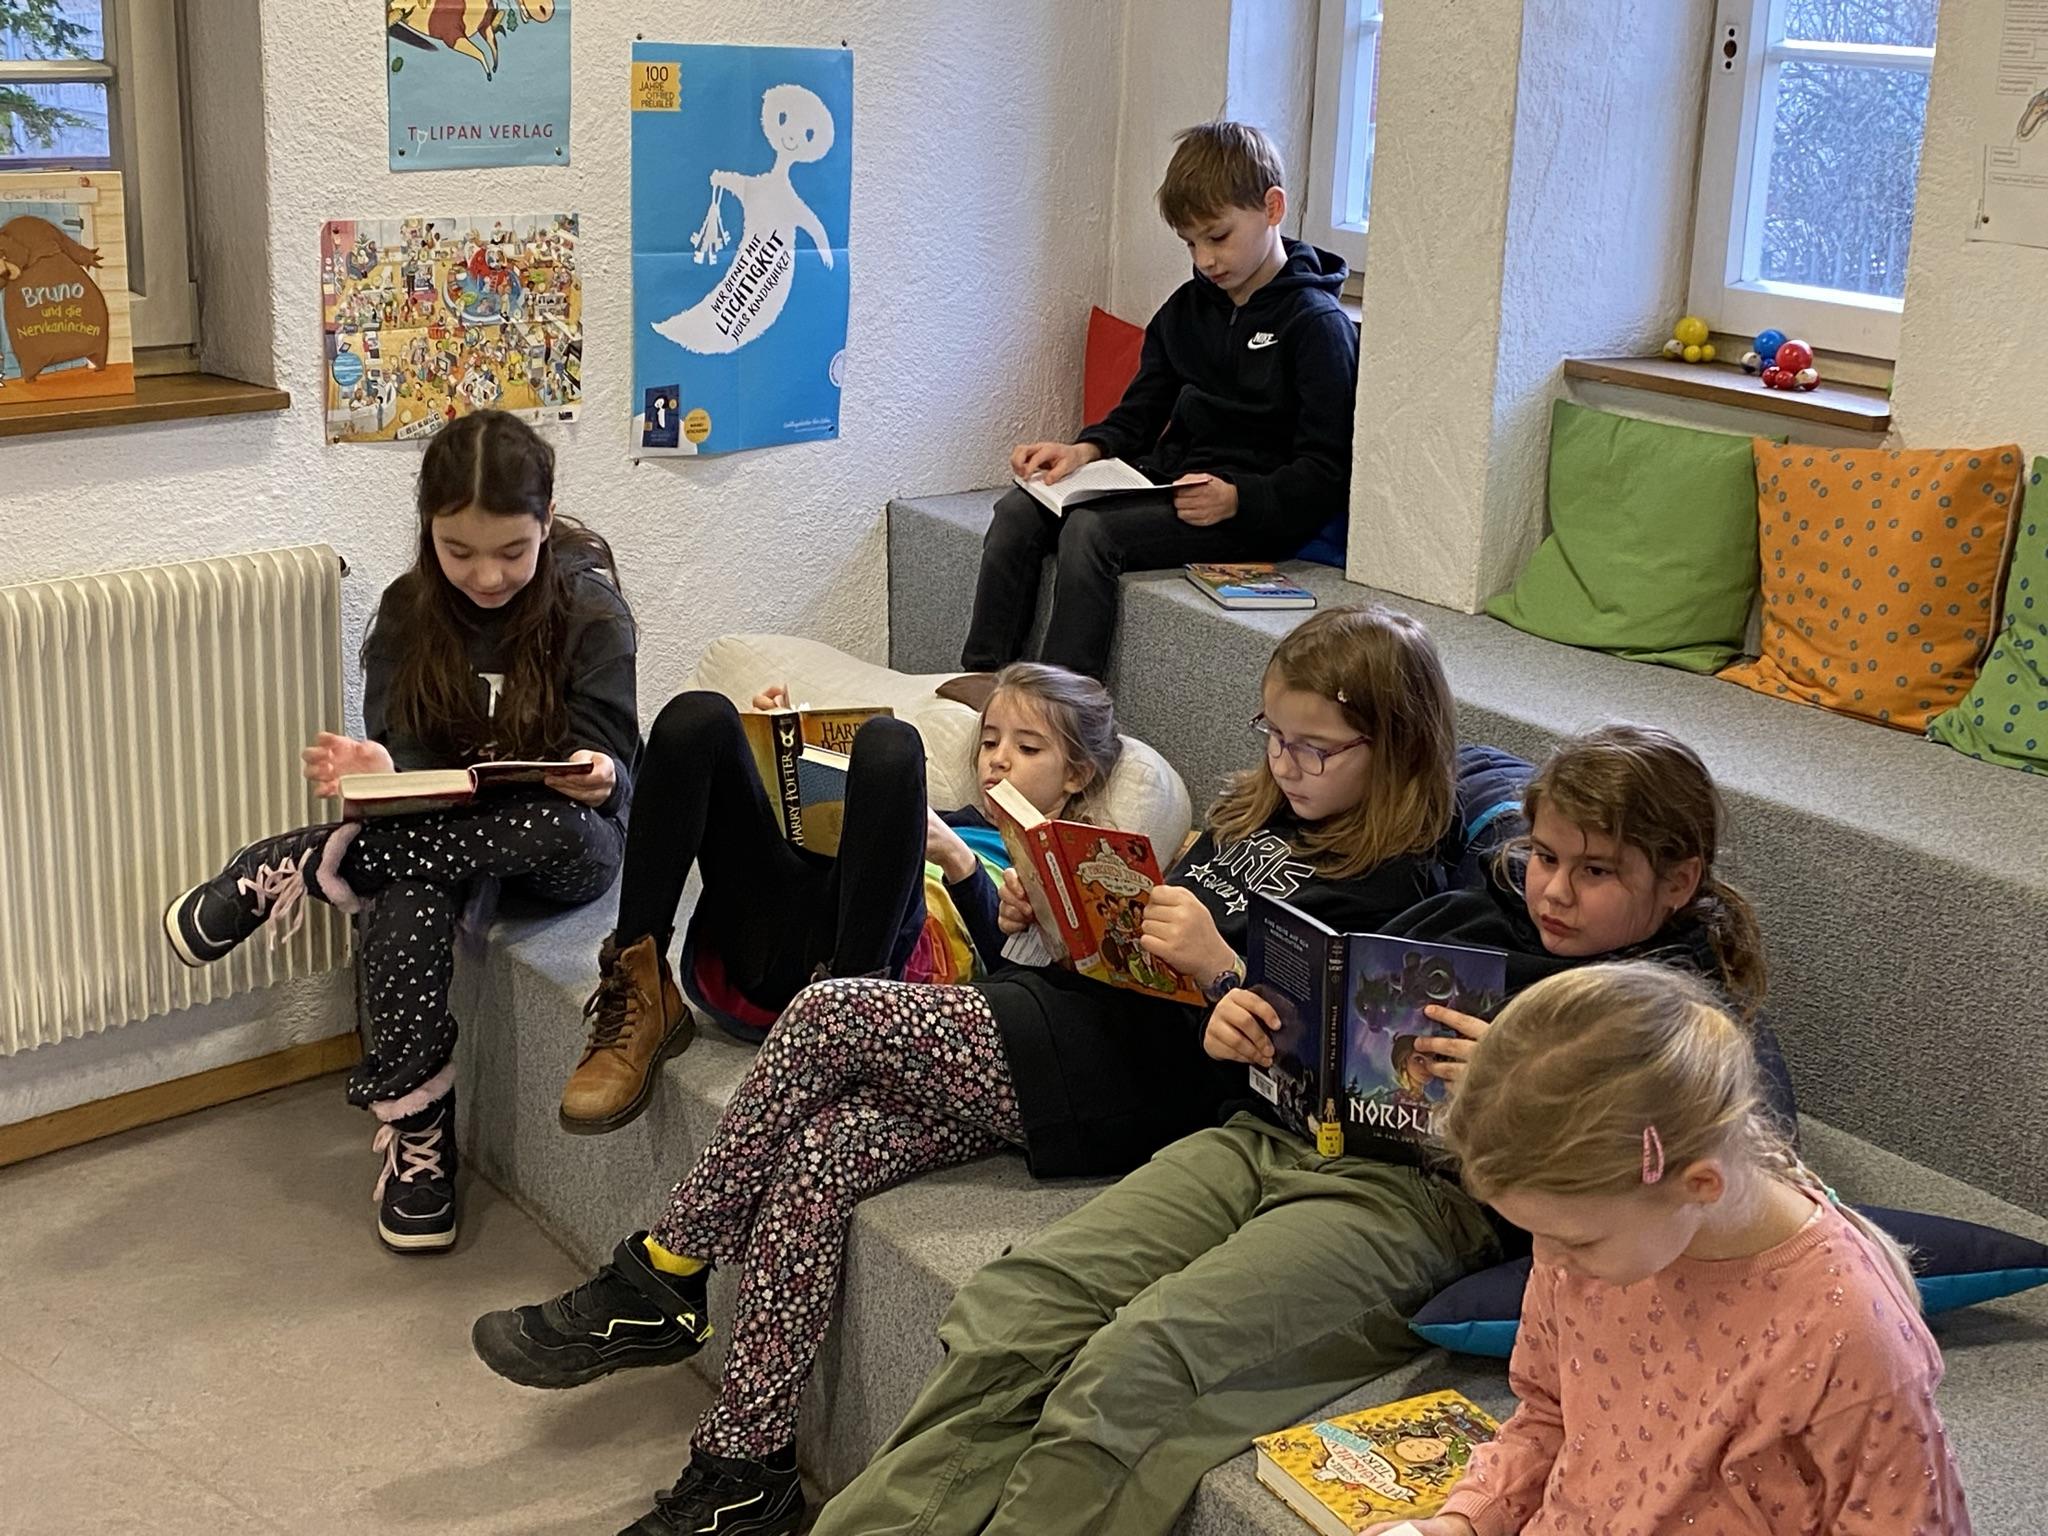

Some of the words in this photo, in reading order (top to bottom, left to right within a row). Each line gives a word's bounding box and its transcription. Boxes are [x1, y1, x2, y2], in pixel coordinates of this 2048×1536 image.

[646, 66, 669, 81] 100
[489, 123, 553, 139] VERLAG
[711, 290, 729, 313] WER
[745, 233, 761, 258] MIT
[716, 229, 784, 336] LEICHTIGKEIT
[21, 282, 84, 308] Bruno
[41, 305, 62, 317] und
[65, 304, 82, 317] die
[17, 319, 100, 339] Nervkaninchen
[821, 721, 860, 741] HAR
[781, 751, 799, 801] POTTER
[787, 804, 804, 846] HARRY
[1349, 1097, 1434, 1136] NORDLI
